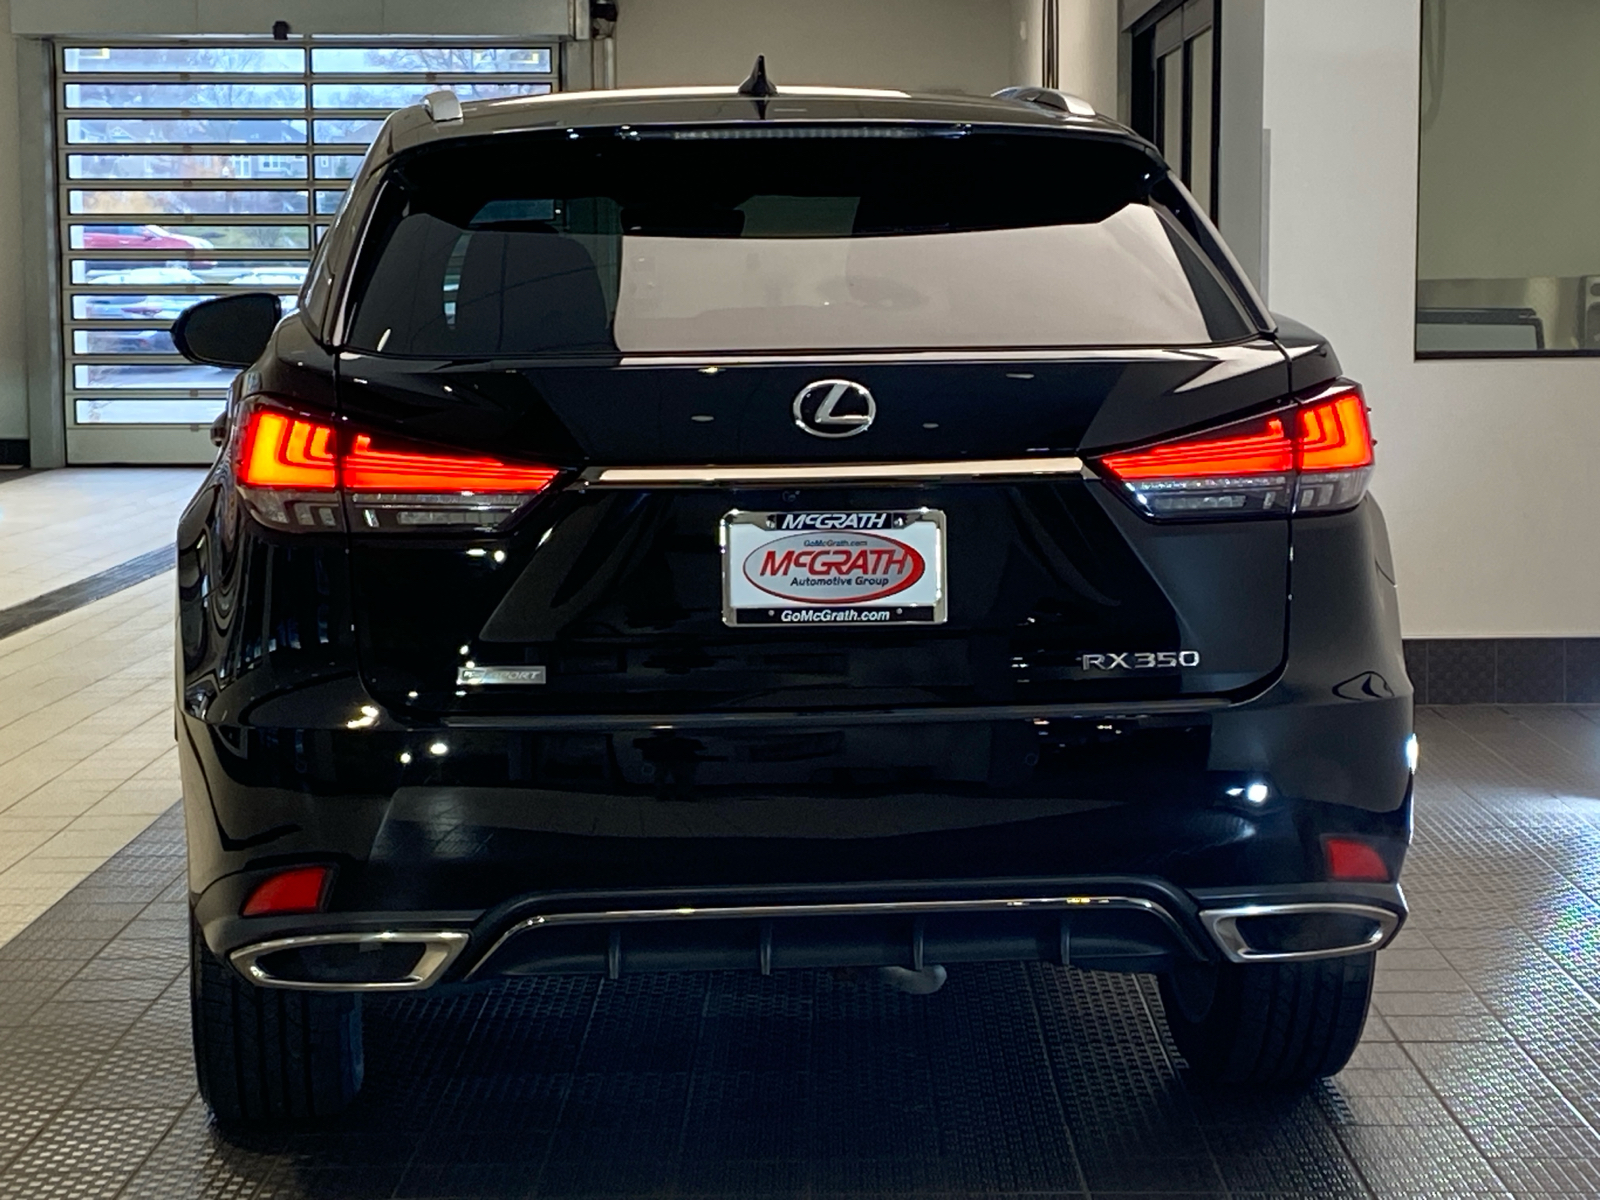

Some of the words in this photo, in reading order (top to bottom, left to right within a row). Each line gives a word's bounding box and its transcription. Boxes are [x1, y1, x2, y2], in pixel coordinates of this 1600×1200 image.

[803, 539, 868, 547] GoMcGrath.com
[790, 576, 852, 587] Automotive
[855, 576, 889, 587] Group
[780, 609, 890, 622] GoMcGrath.com
